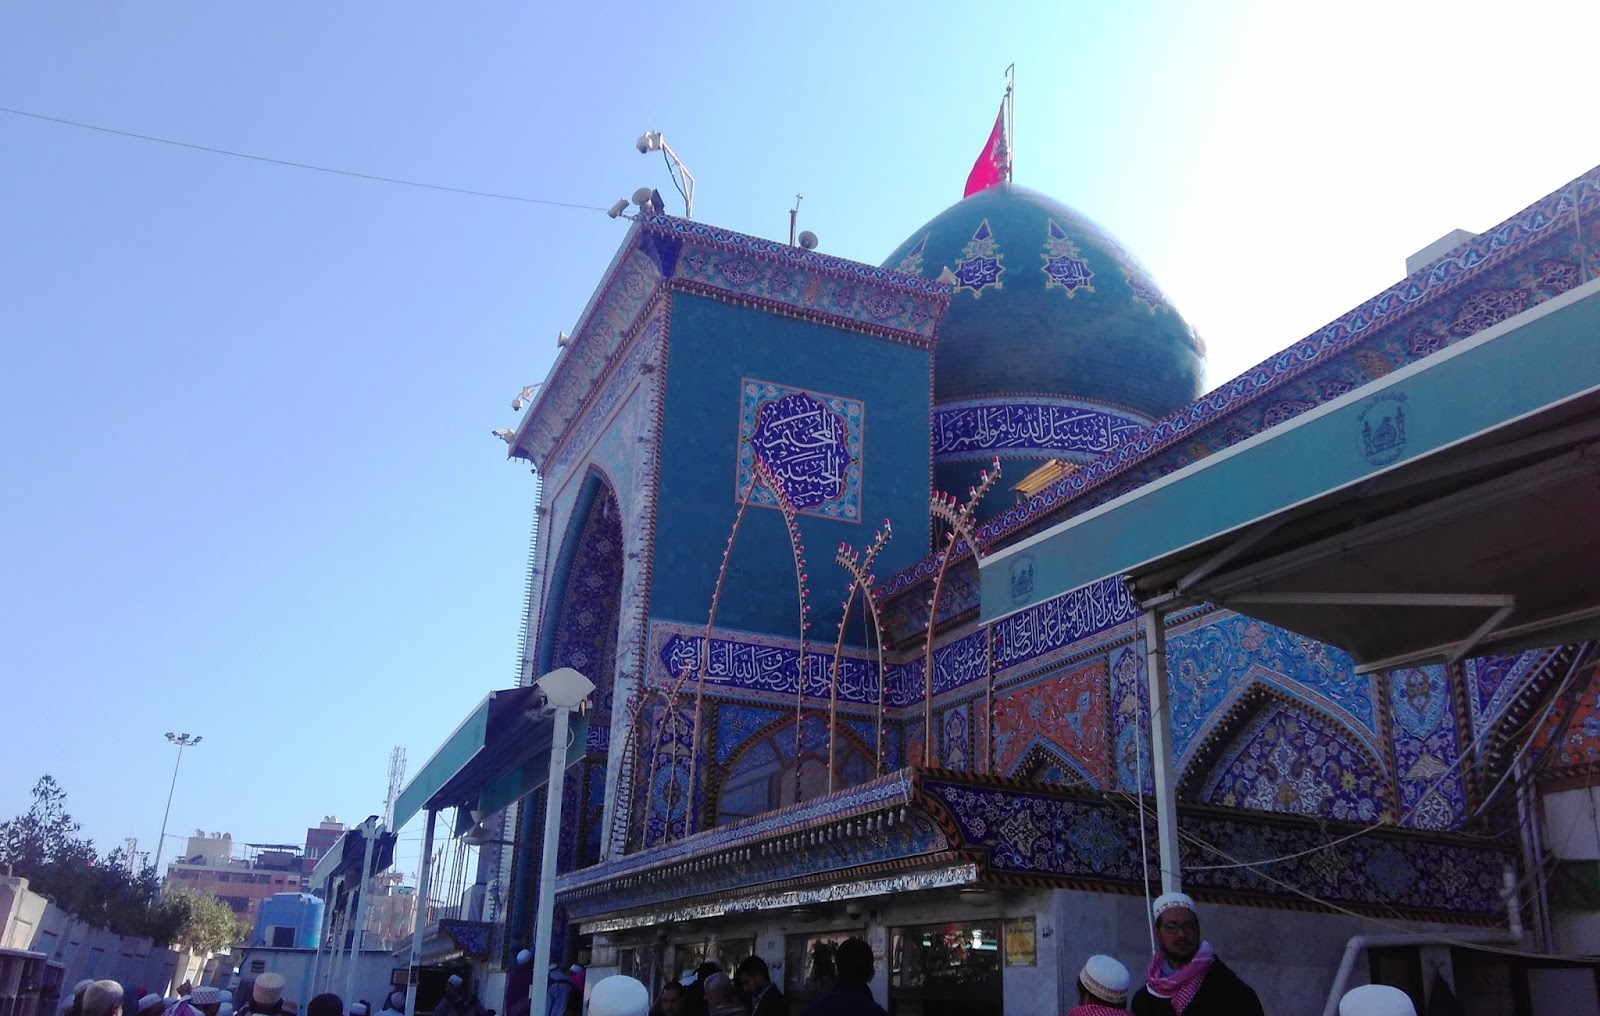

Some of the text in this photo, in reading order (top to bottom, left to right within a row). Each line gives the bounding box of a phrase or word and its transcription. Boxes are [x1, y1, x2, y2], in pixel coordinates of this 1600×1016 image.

[763, 408, 838, 455] المخيم
[1013, 407, 1043, 439] الله
[731, 645, 757, 679] الله
